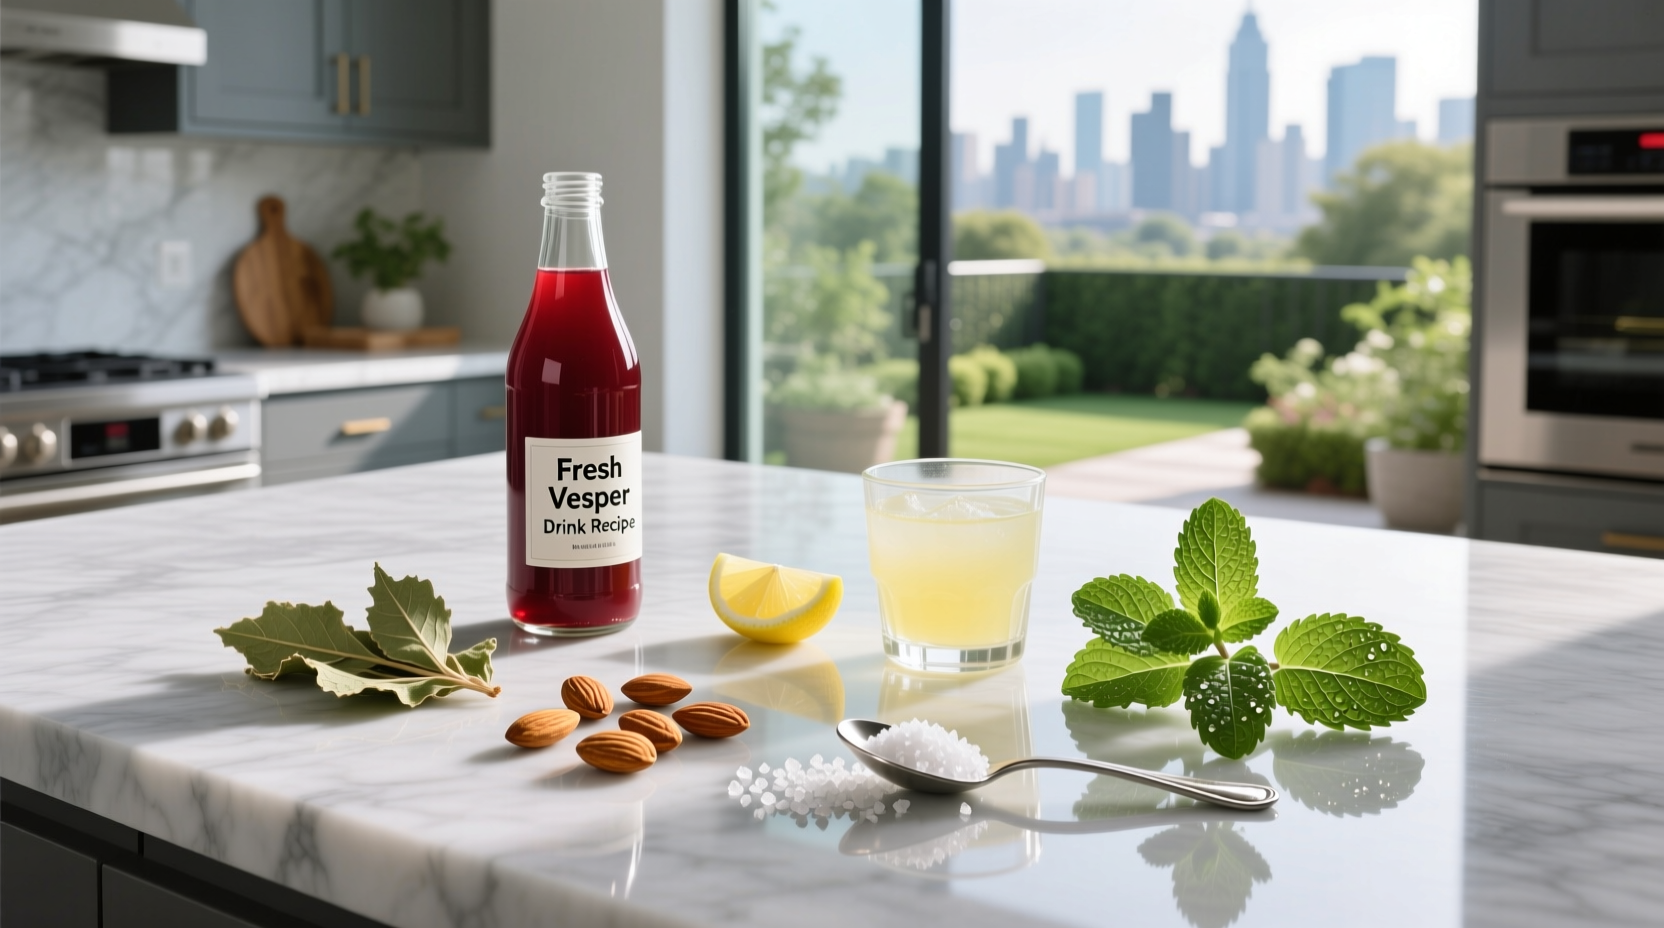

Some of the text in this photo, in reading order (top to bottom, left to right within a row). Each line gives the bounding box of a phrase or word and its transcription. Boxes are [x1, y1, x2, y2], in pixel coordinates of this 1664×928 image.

[557, 455, 622, 481] Fresh
[548, 486, 630, 514] Vesper
[544, 516, 636, 535] Drink Recipe
